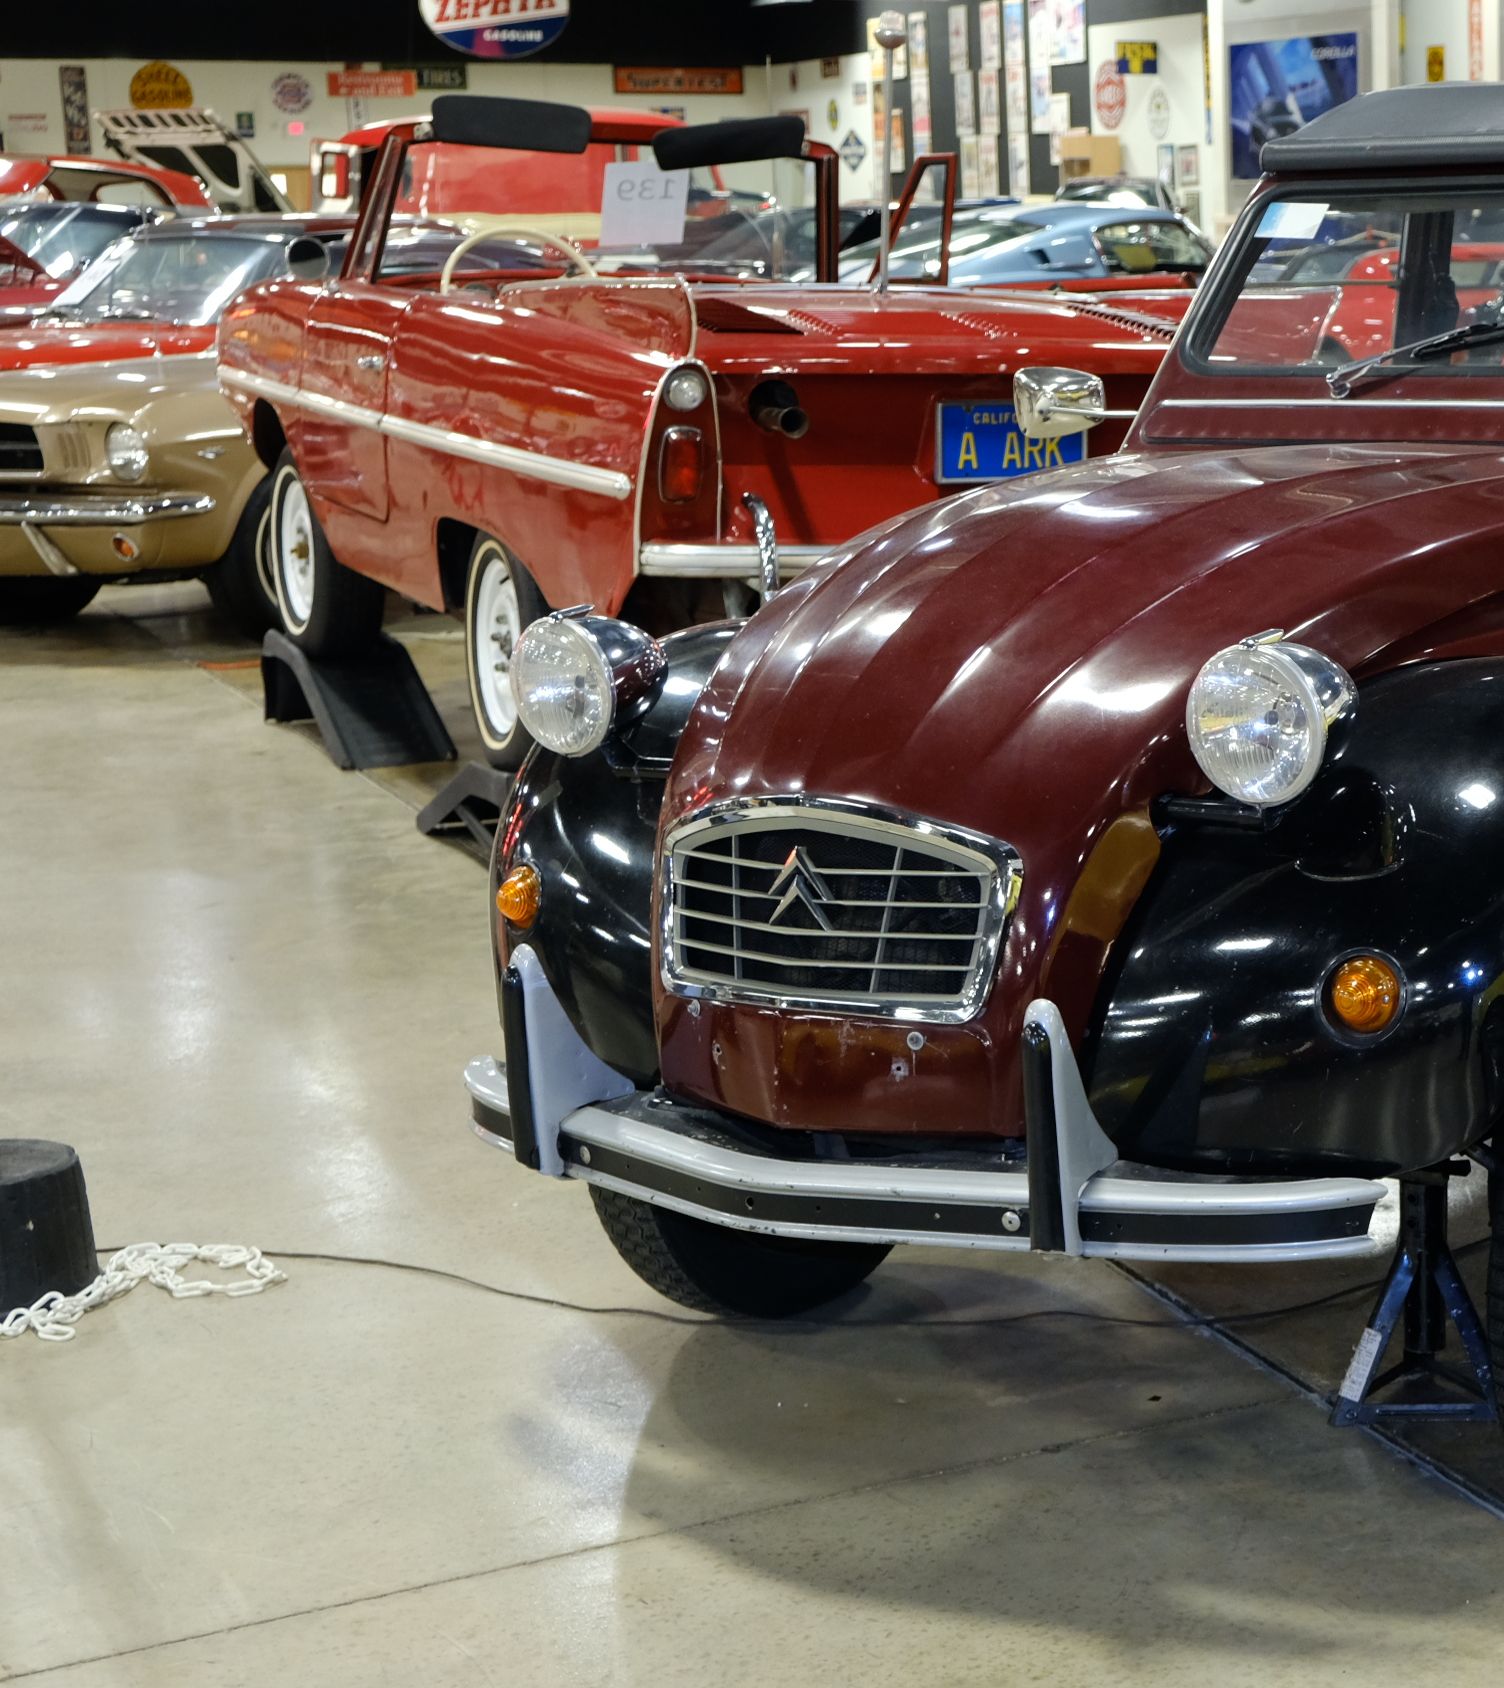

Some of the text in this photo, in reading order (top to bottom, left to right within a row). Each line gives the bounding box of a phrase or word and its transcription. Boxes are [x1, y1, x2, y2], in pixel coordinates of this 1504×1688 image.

[482, 29, 544, 42] GASOLINE
[973, 412, 1019, 425] CALIFO
[958, 431, 1065, 470] A ARK
